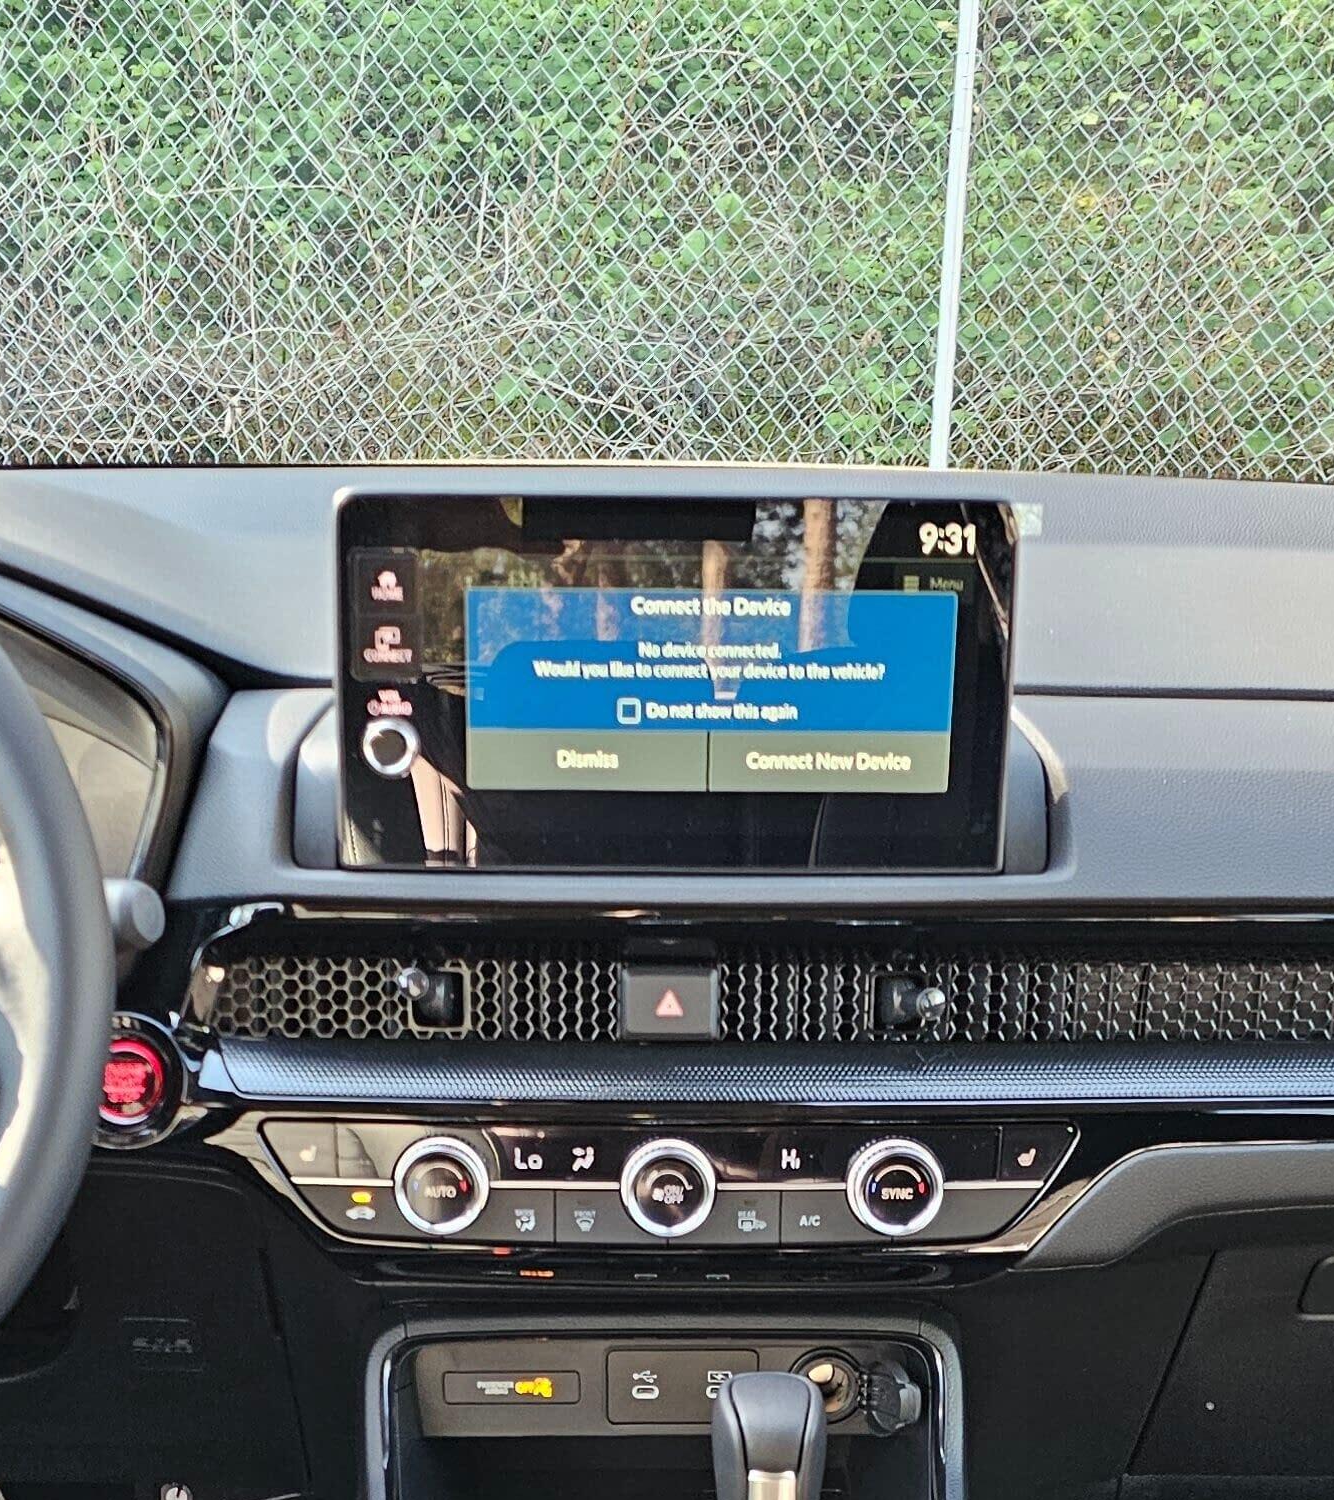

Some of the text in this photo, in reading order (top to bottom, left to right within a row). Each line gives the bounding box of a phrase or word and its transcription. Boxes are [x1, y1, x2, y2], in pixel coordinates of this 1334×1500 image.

[919, 522, 977, 556] 9:31
[929, 577, 964, 591] Menu
[630, 596, 791, 617] Connect the Device
[638, 641, 782, 659] No device connected.
[533, 660, 886, 681] Would you like to connect your device to the vehicle?
[646, 702, 798, 722] Do not show this again
[556, 749, 619, 768] Dismiss
[746, 751, 911, 771] Connect New Device
[424, 1185, 457, 1199] AUTO
[881, 1187, 914, 1201] SYNC
[799, 1214, 822, 1228] A/C
